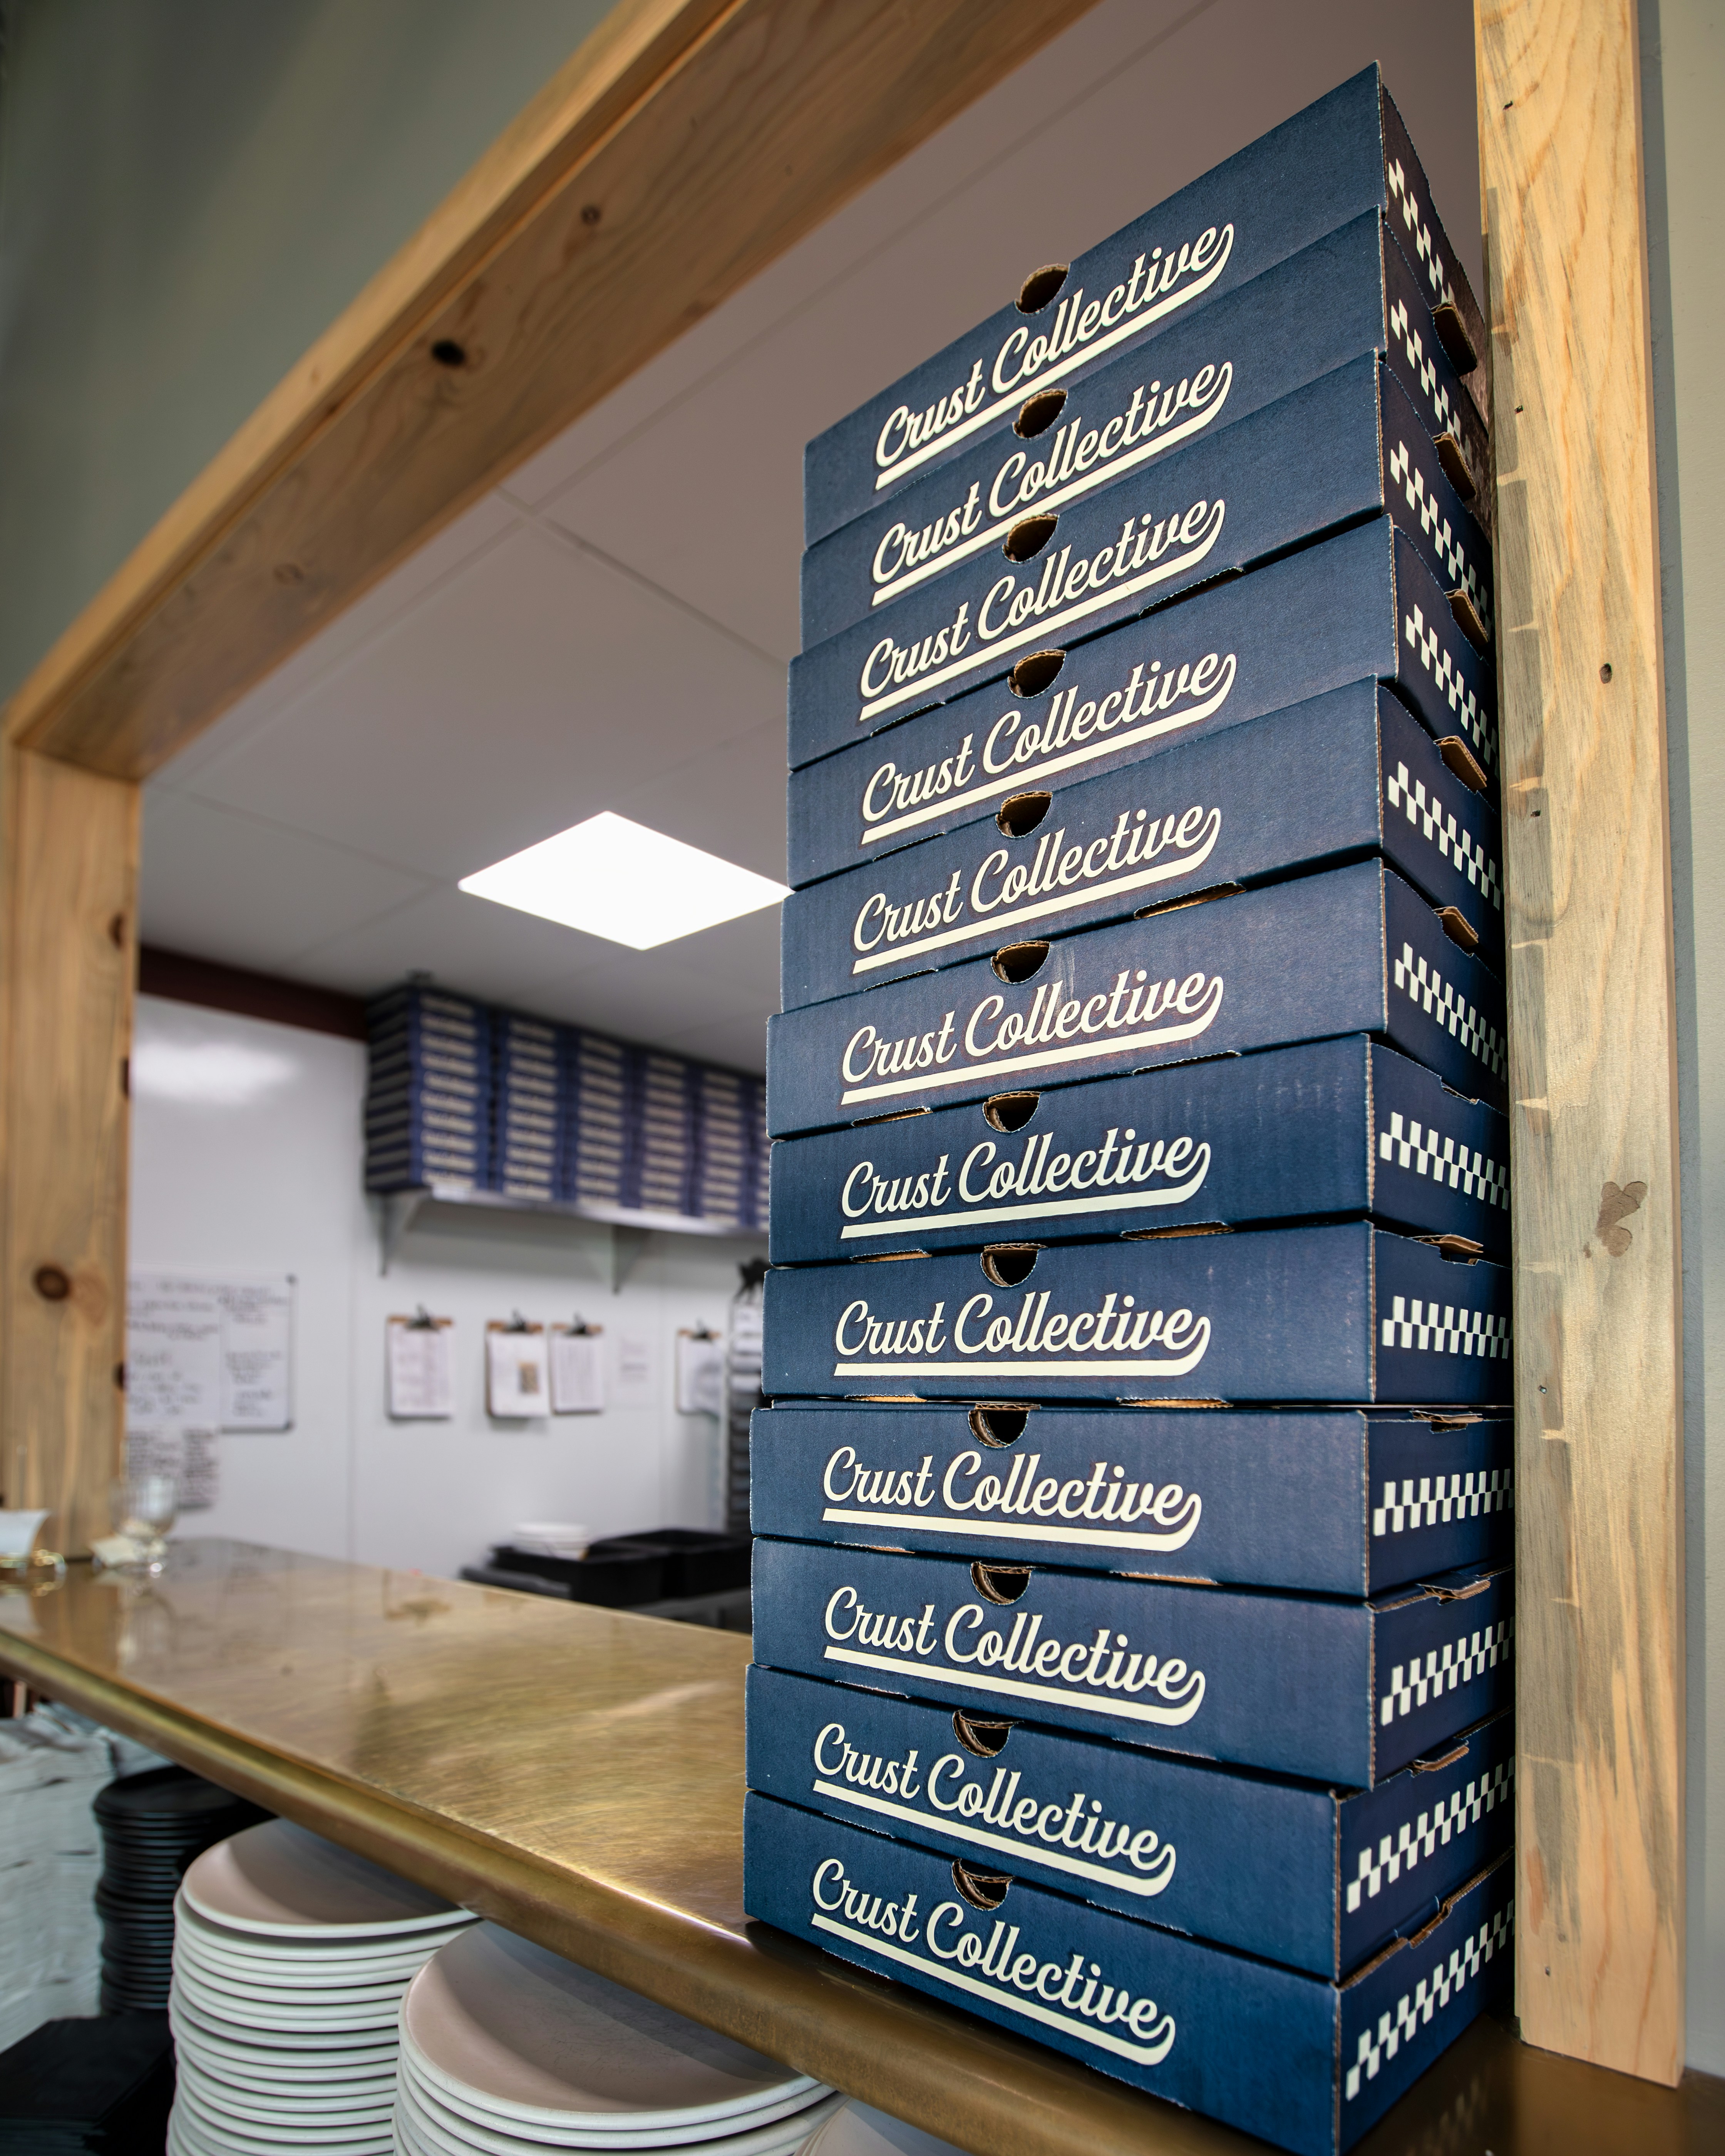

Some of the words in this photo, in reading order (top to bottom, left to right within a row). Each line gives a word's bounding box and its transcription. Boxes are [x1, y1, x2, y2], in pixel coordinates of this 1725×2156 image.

[876, 358, 986, 467] Crust
[991, 223, 1234, 393] Collective
[873, 480, 983, 583] Crust
[989, 361, 1233, 517] Collective
[861, 601, 971, 698] Crust
[978, 499, 1226, 640] Collective
[862, 732, 976, 822] Crust
[983, 653, 1237, 774] Collective
[853, 869, 964, 952] Crust
[971, 805, 1222, 913] Collective
[842, 1010, 958, 1083] Crust
[965, 969, 1224, 1057] Collective
[842, 1153, 952, 1218] Crust
[958, 1127, 1211, 1203] Collective
[835, 1300, 947, 1356] Crust
[954, 1290, 1211, 1354] Collective
[823, 1446, 936, 1507] Crust
[943, 1450, 1202, 1526] Collective
[825, 1586, 938, 1656] Crust
[945, 1604, 1206, 1700] Collective
[814, 1723, 920, 1799] Crust
[927, 1754, 1176, 1871] Collective
[812, 1858, 919, 1943] Crust
[926, 1902, 1176, 2039] Collective
